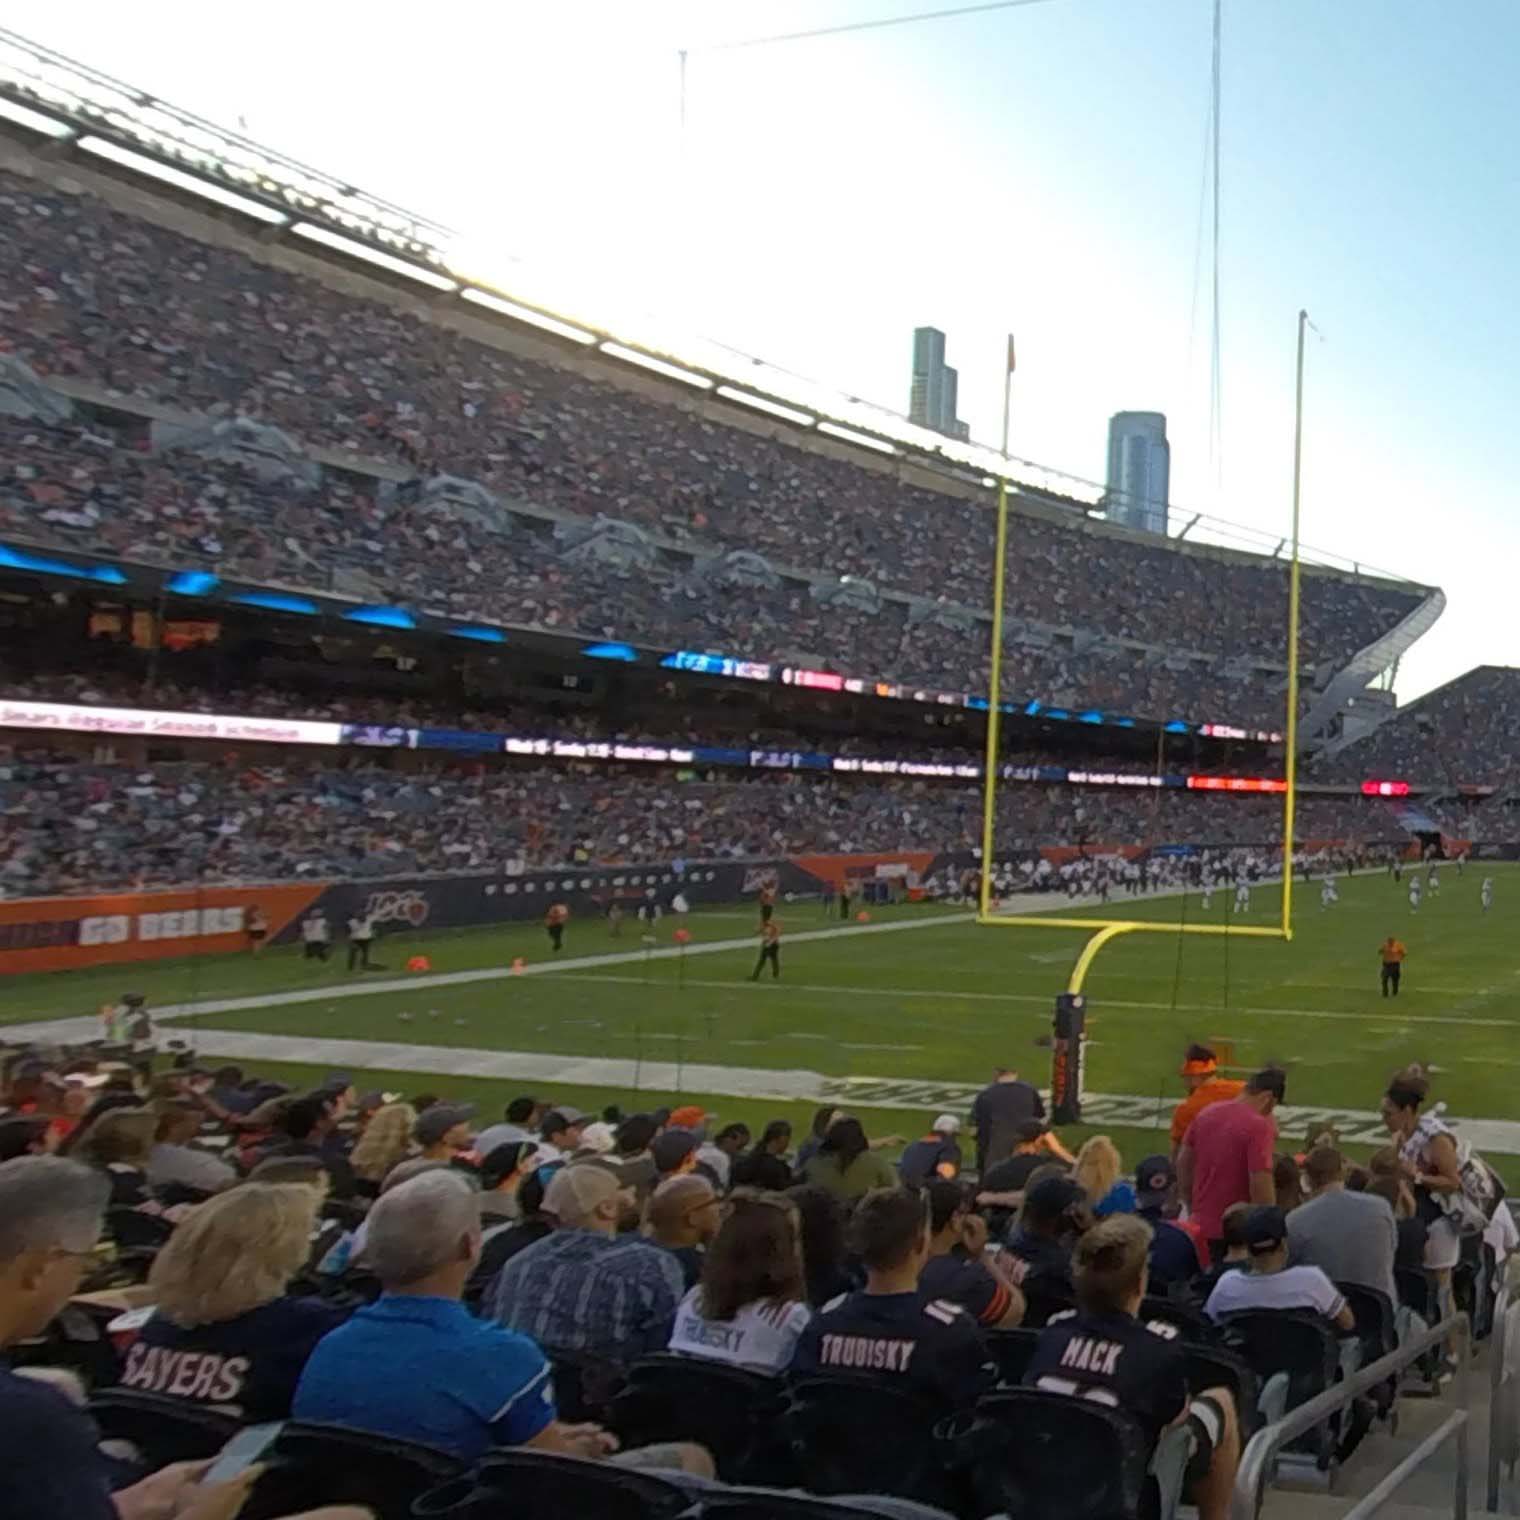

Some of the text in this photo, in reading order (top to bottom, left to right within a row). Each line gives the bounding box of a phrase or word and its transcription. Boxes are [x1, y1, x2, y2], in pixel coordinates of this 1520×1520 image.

[138, 906, 245, 942] BEARS
[120, 1341, 251, 1400] SAYERS
[821, 1333, 917, 1373] TRUBISKY
[1060, 1336, 1125, 1375] MACK
